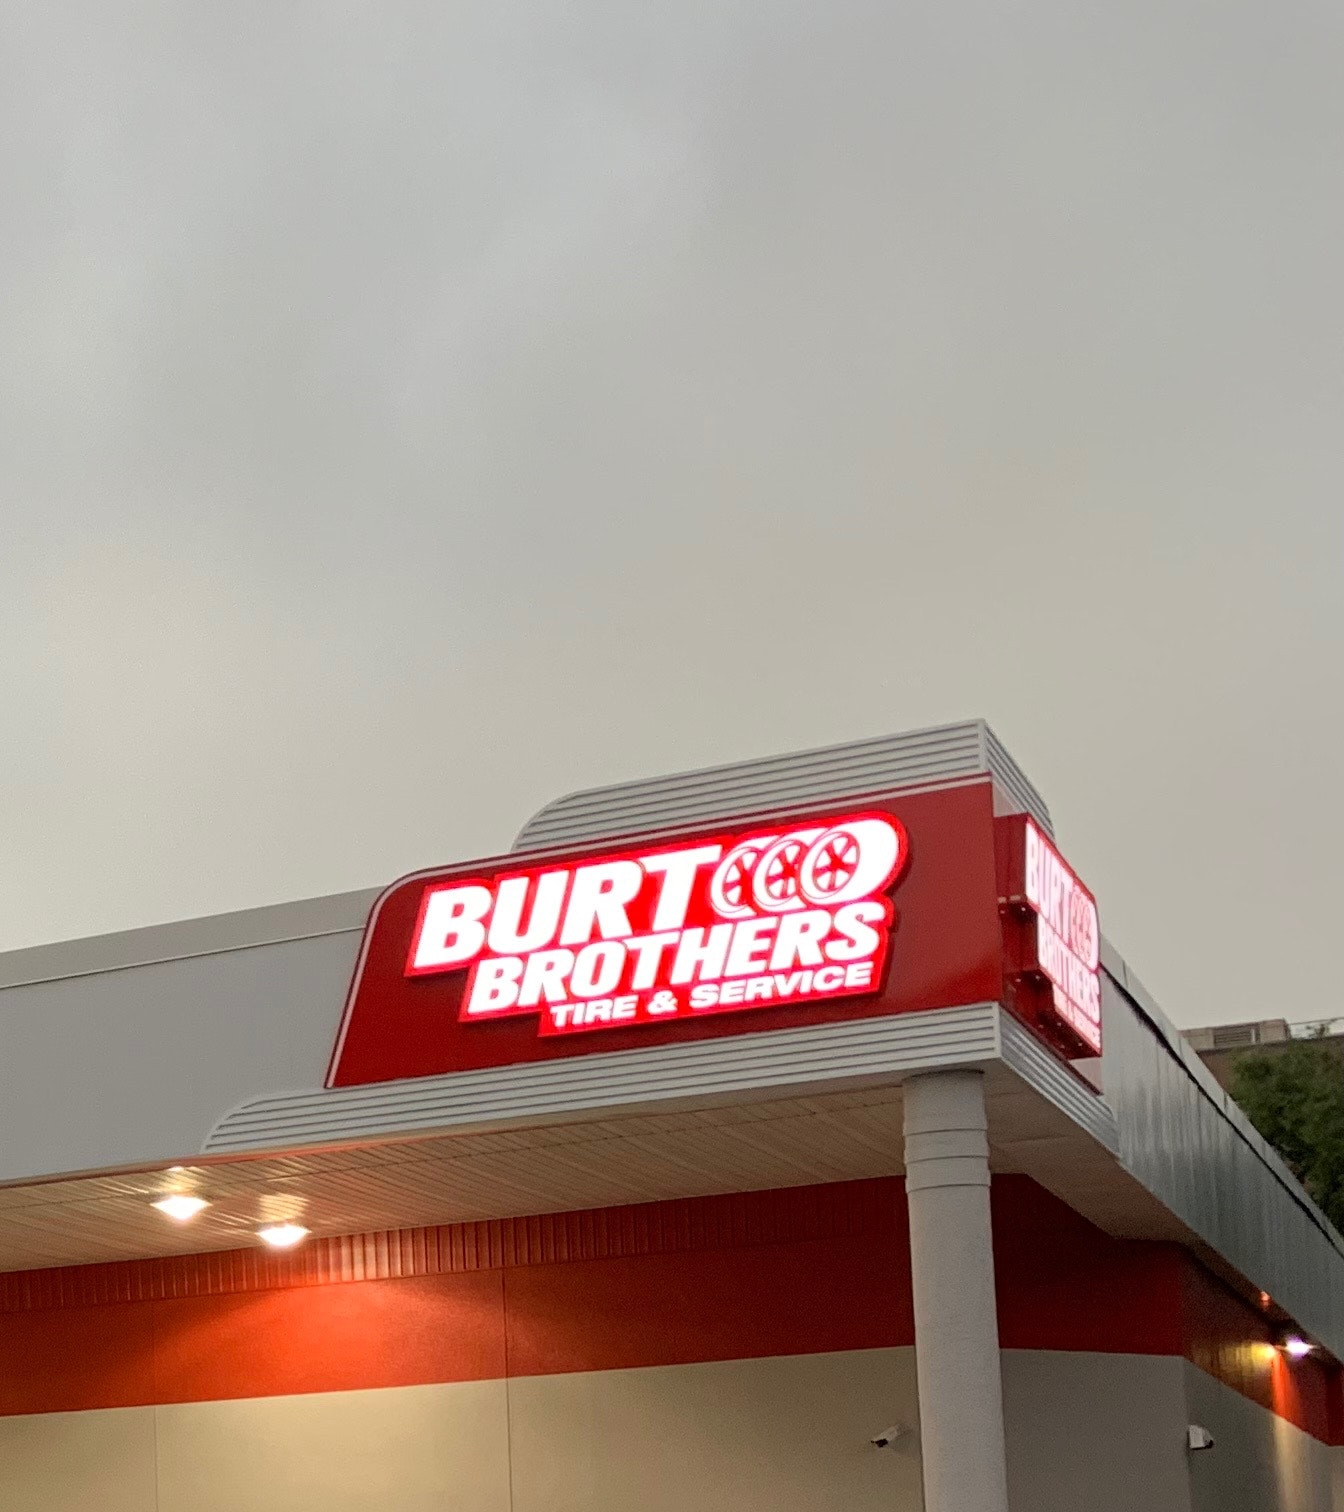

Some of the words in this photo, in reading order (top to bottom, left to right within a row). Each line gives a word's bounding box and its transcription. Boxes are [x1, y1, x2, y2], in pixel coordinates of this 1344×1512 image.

[412, 844, 723, 969] BURT
[1025, 823, 1073, 946] BURT
[467, 901, 887, 1015] BROTHERS
[550, 998, 638, 1029] TIRE
[647, 991, 680, 1015] &
[691, 962, 874, 1010] SERVICE
